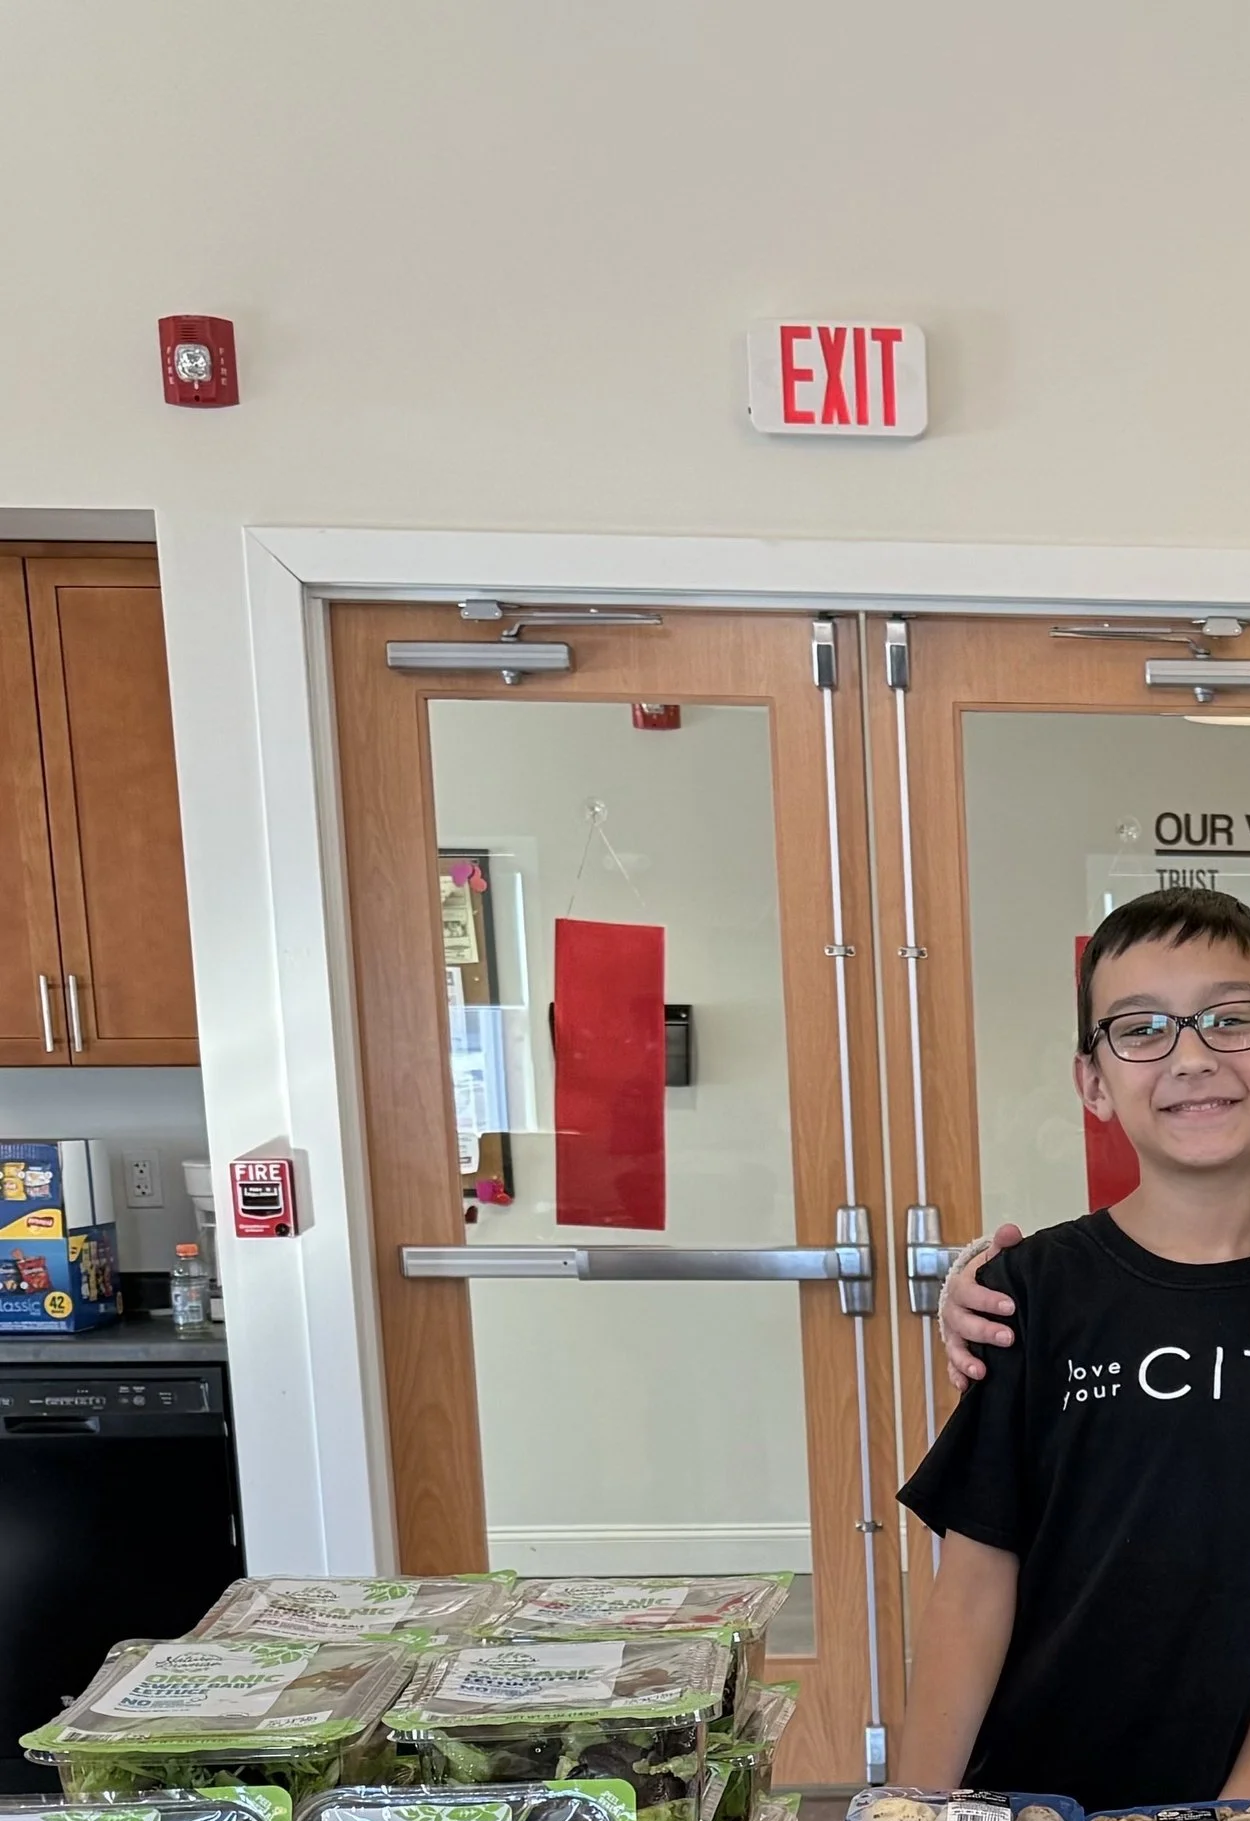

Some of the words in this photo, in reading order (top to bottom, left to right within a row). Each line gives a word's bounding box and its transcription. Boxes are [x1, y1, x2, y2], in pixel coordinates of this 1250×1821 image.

[219, 347, 228, 386] FIRE
[780, 325, 902, 427] EXIT
[1155, 812, 1234, 846] OUR
[1156, 868, 1219, 891] TRUST
[234, 1164, 282, 1181] FIRE
[49, 1296, 66, 1310] 42
[1068, 1359, 1121, 1382] love
[140, 1681, 207, 1689] SWEET
[145, 1674, 285, 1683] ORGANIC
[121, 1697, 151, 1707] NO
